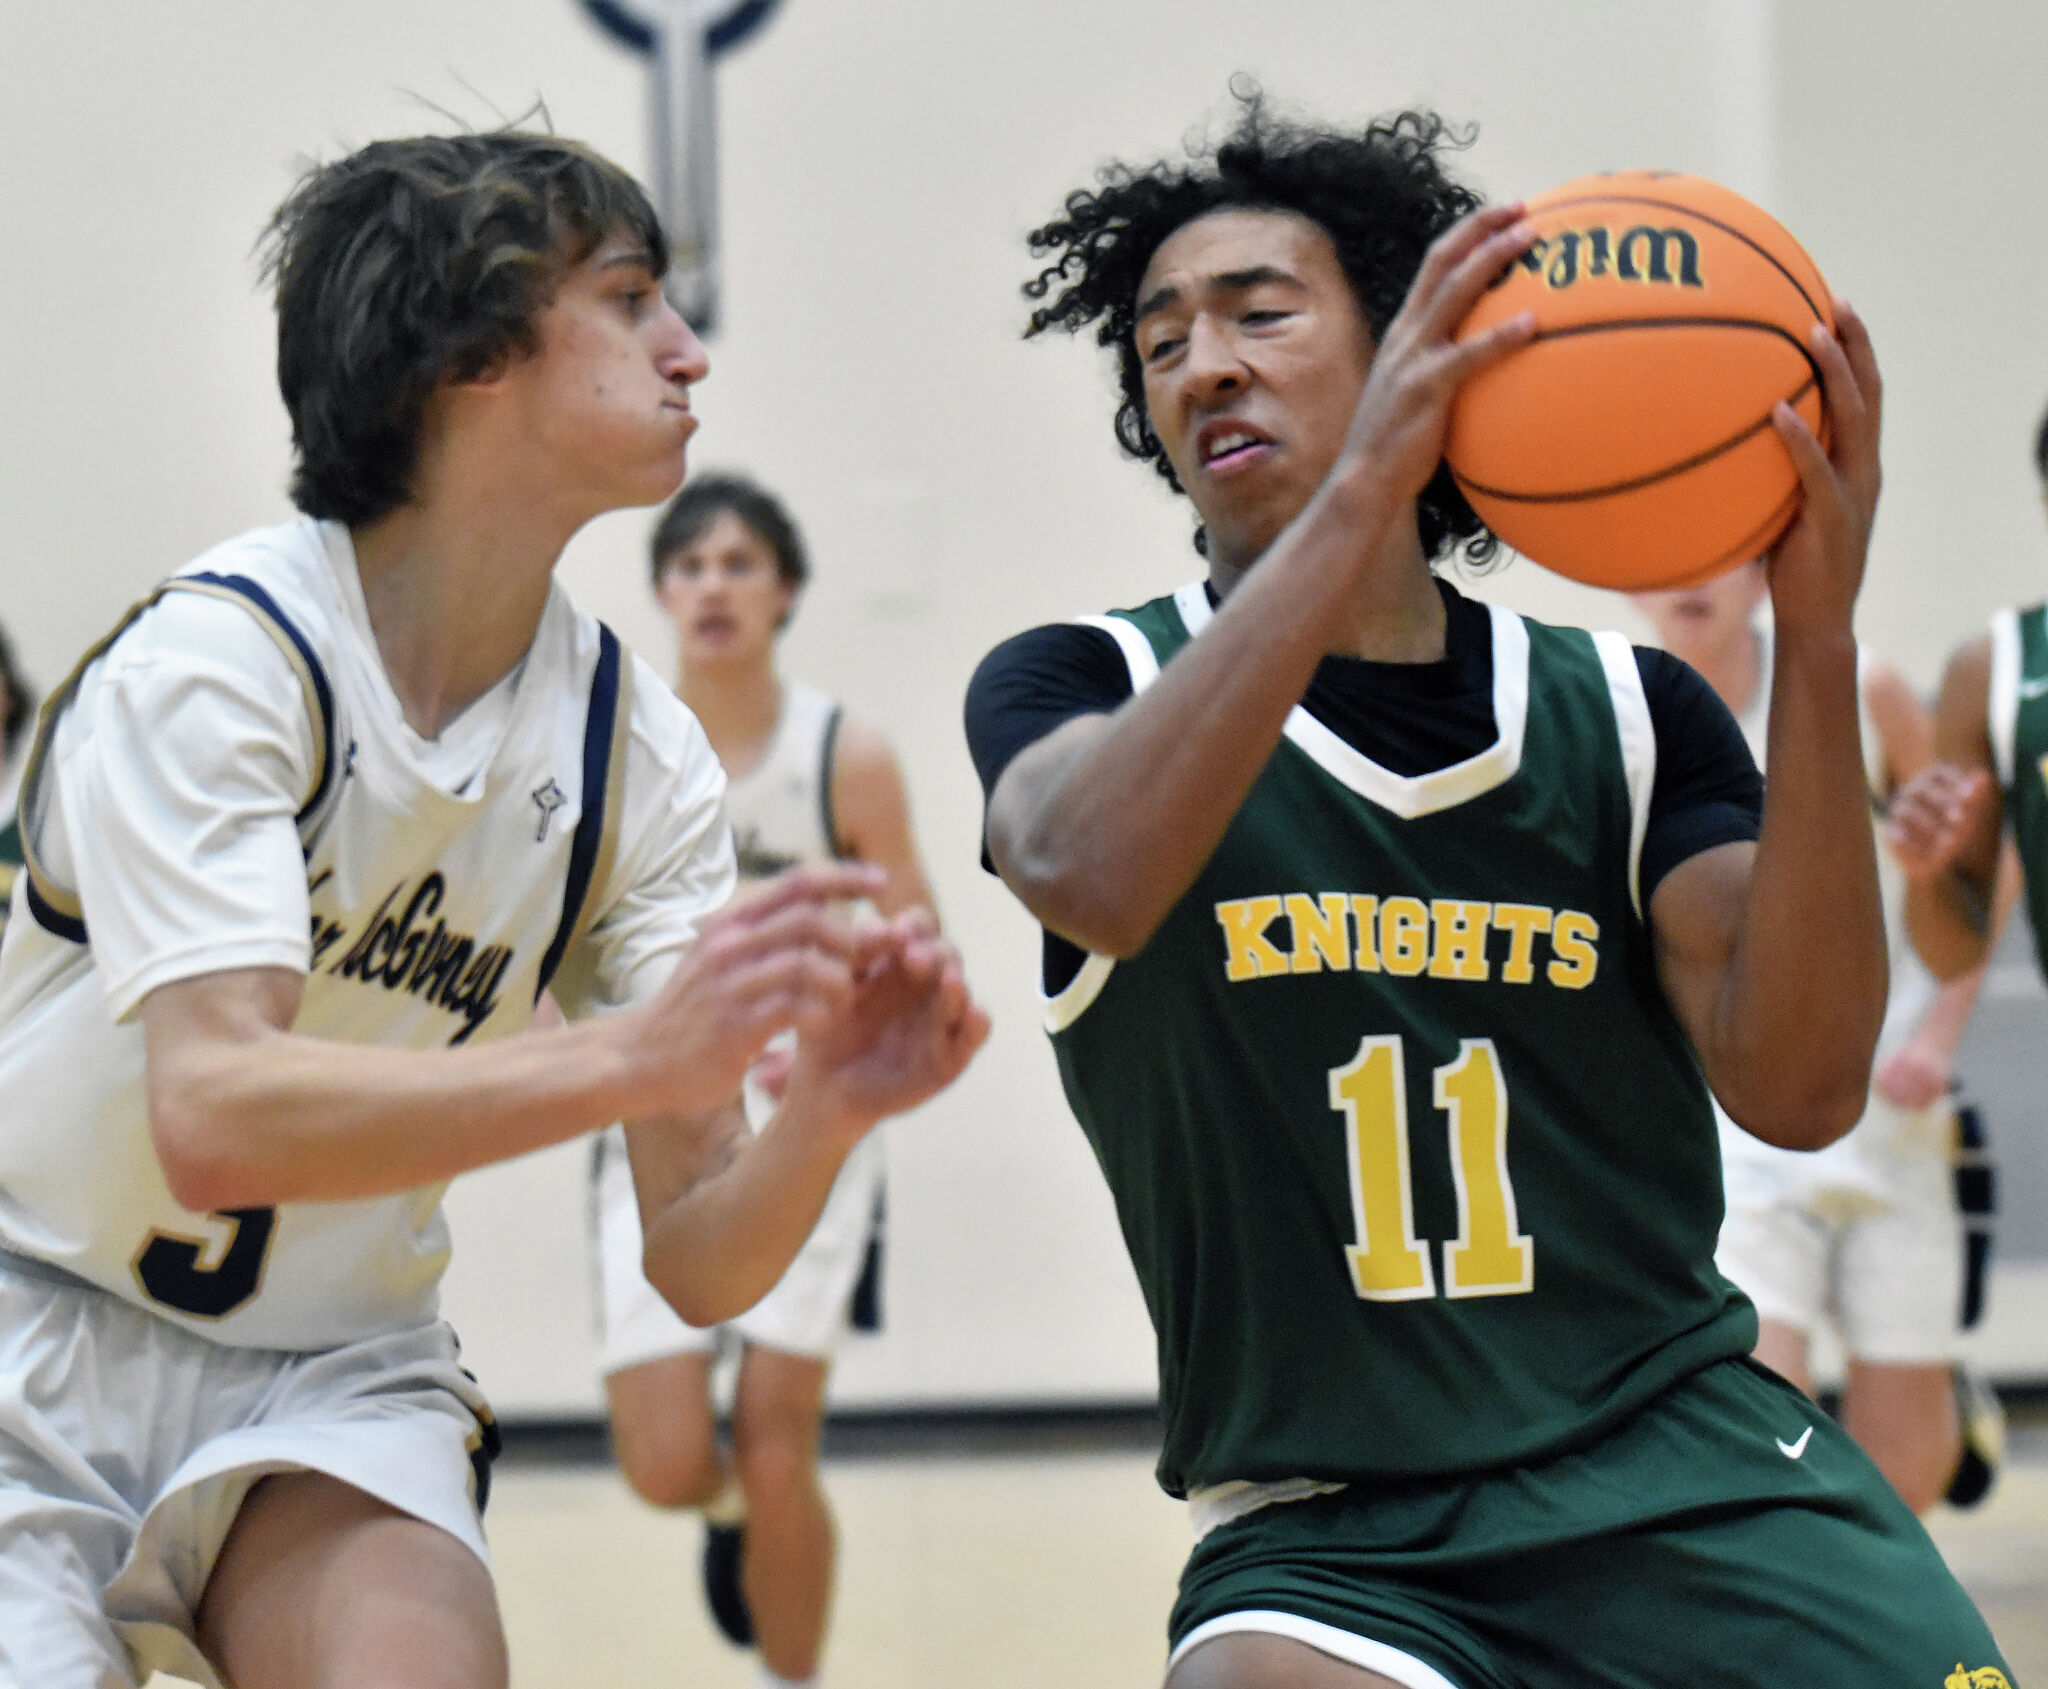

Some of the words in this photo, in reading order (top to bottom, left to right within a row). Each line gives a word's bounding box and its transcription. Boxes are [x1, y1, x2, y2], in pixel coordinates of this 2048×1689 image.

[1488, 223, 1704, 289] Wils
[1214, 892, 1599, 990] KNIGHTS
[1328, 1034, 1535, 1301] 11
